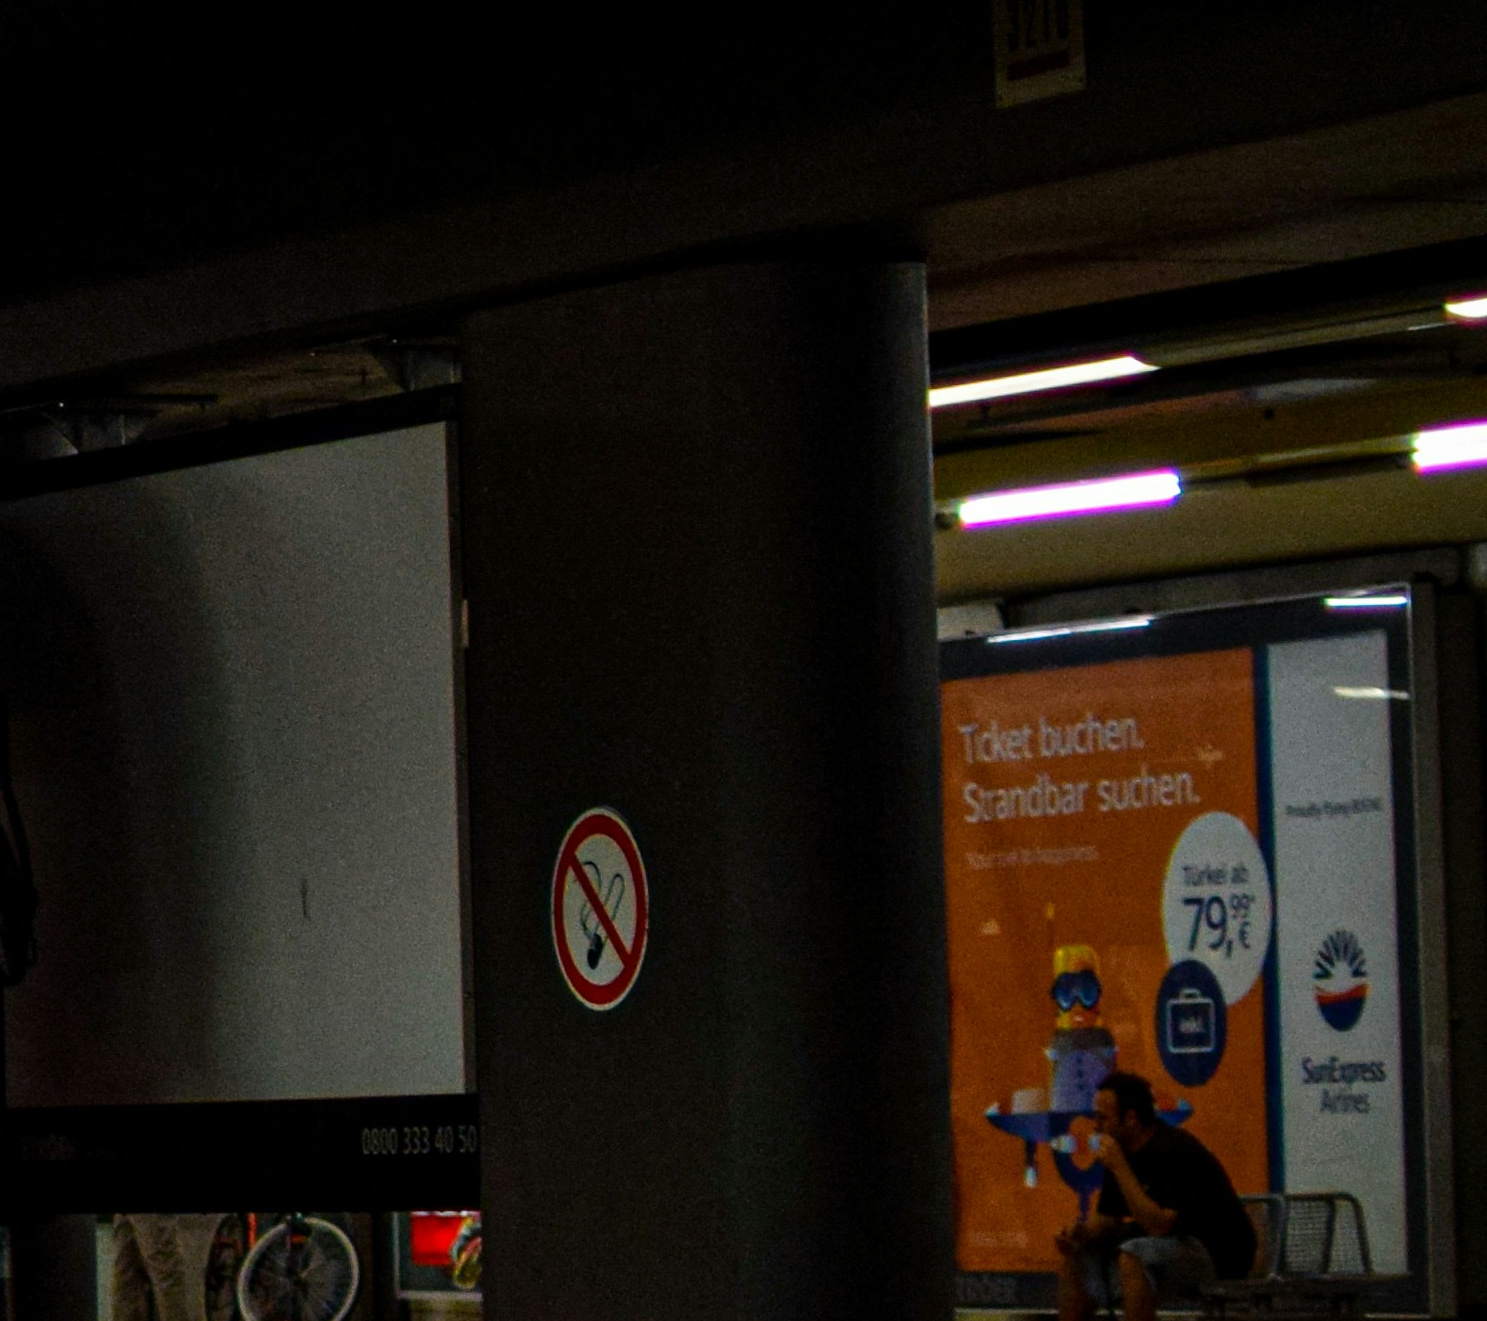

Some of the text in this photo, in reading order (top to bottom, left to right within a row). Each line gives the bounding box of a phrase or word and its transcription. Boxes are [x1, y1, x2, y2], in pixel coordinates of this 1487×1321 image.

[958, 712, 1145, 764] Ticket buchen.
[963, 763, 1202, 823] Strandbar suchen.
[1182, 864, 1249, 886] Türkei ab
[1302, 1056, 1387, 1087] SunExpress
[361, 1125, 478, 1156] 0800 333 40 50
